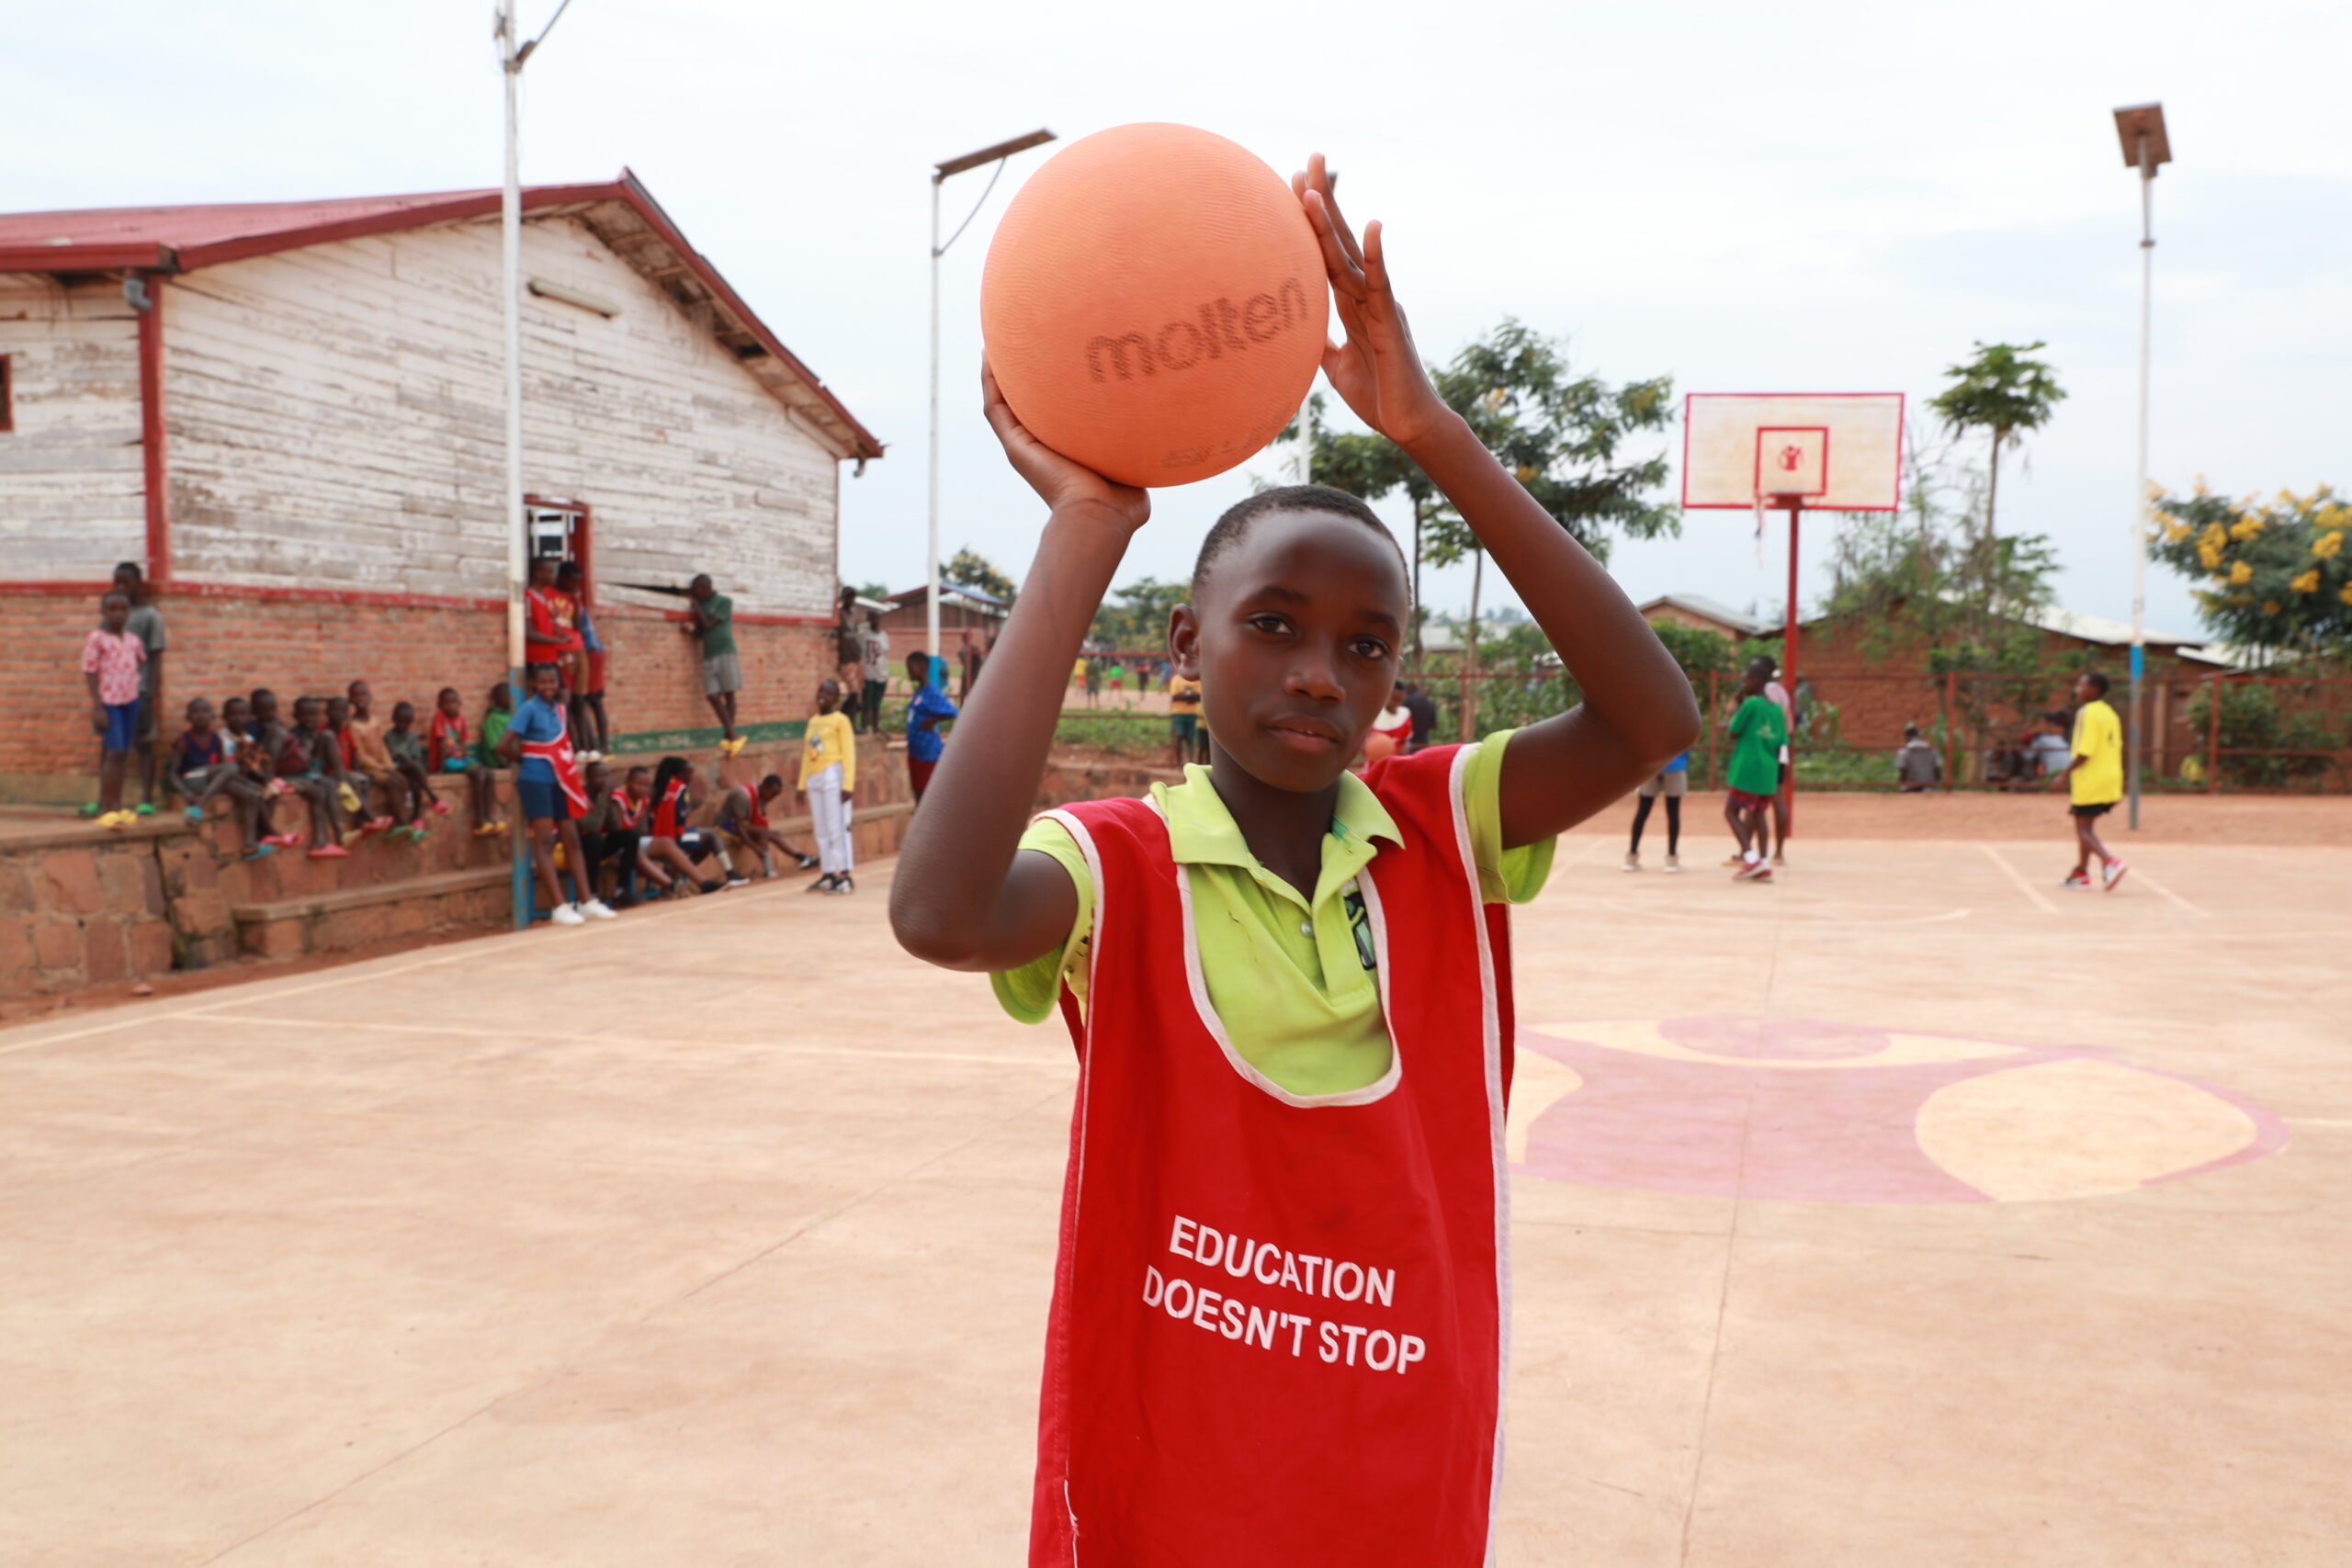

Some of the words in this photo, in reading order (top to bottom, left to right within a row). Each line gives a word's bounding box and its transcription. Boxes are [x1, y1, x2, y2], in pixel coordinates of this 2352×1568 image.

[1086, 277, 1307, 383] molten
[1170, 1214, 1396, 1307] EDUCATION
[1142, 1264, 1311, 1358] DOESN'T
[1317, 1321, 1426, 1374] STOP
